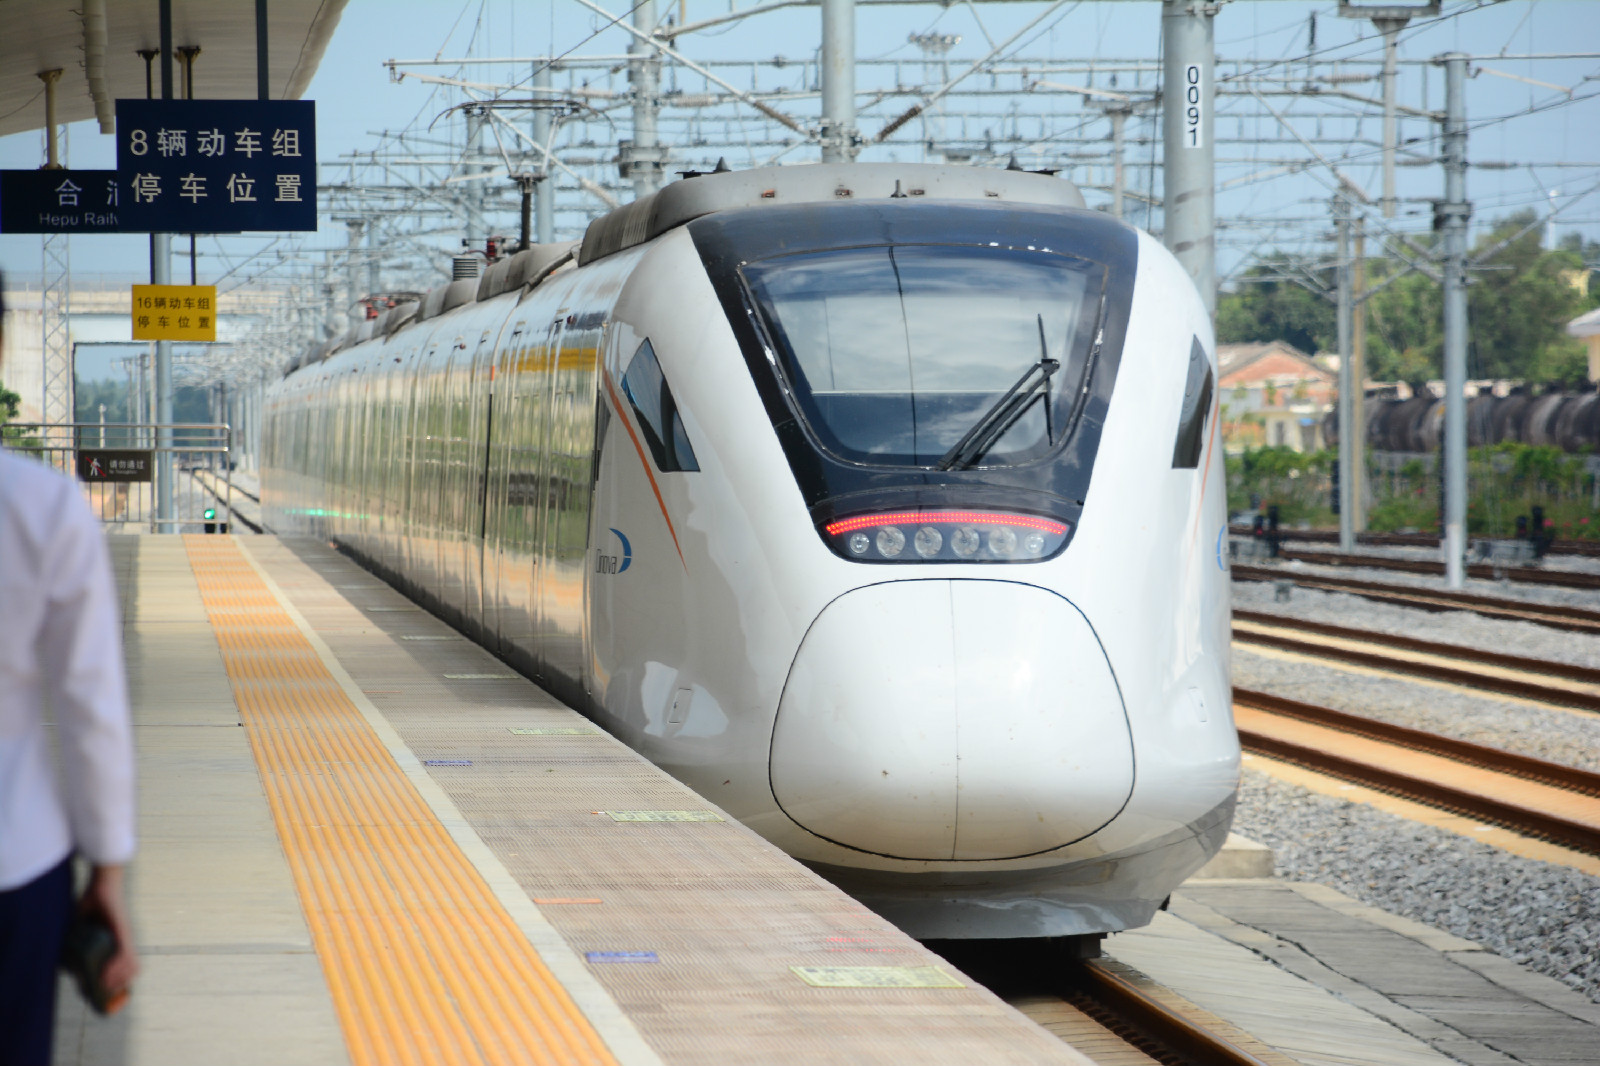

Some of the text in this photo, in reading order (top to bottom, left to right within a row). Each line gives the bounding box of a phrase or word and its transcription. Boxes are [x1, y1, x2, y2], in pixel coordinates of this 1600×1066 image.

[1187, 66, 1199, 147] 0091
[130, 127, 302, 158] 8辆动车组
[131, 172, 303, 204] 停车位置
[39, 212, 79, 228] Hepu
[137, 297, 210, 310] 16辆动车组
[137, 315, 210, 329] 停车位置
